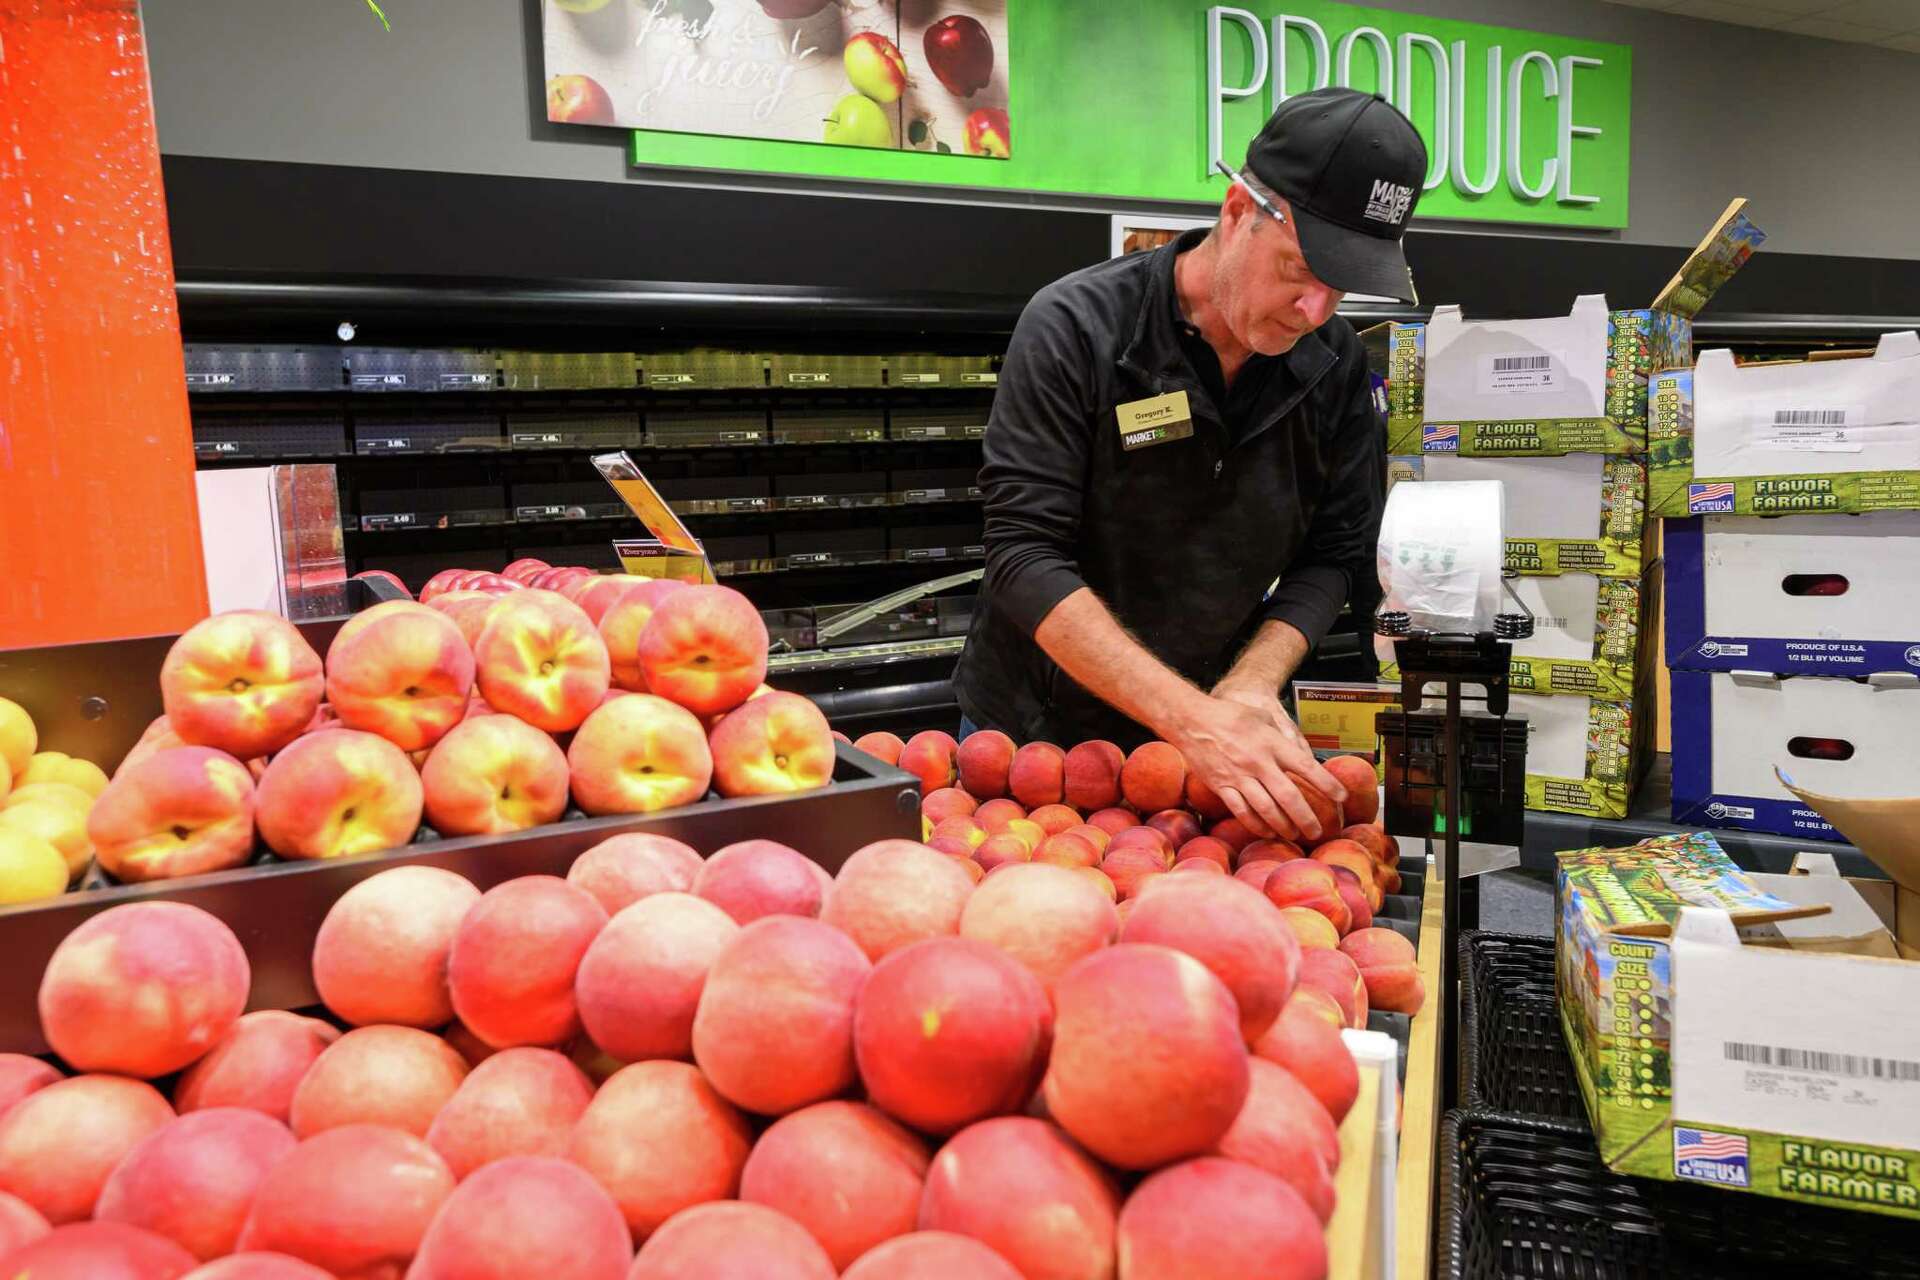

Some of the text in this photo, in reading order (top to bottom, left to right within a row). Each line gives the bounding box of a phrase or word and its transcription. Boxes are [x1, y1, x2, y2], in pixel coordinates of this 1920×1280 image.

[1616, 317, 1641, 325] COUNT
[1395, 330, 1417, 338] COUNT
[1620, 328, 1636, 336] SIZE
[1658, 380, 1676, 388] SIZE
[1125, 430, 1156, 446] MARKET
[1474, 438, 1541, 449] FARMER
[1442, 440, 1457, 450] USA
[1715, 500, 1732, 511] USA
[1753, 495, 1837, 509] FARMER
[1506, 542, 1537, 555] VOR
[1506, 556, 1541, 568] MER
[1786, 643, 1827, 651] PRODUCE
[1829, 655, 1865, 663] VOLUME
[1305, 690, 1357, 701] Everyone
[1791, 809, 1823, 818] PRODU
[1794, 820, 1806, 828] 1/2
[1610, 943, 1655, 959] COUNT
[1617, 960, 1647, 976] SIZE
[1616, 1050, 1632, 1063] 72
[1783, 1142, 1906, 1179] FLAVOR
[1717, 1162, 1745, 1184] USA
[1779, 1167, 1919, 1206] FARMER
